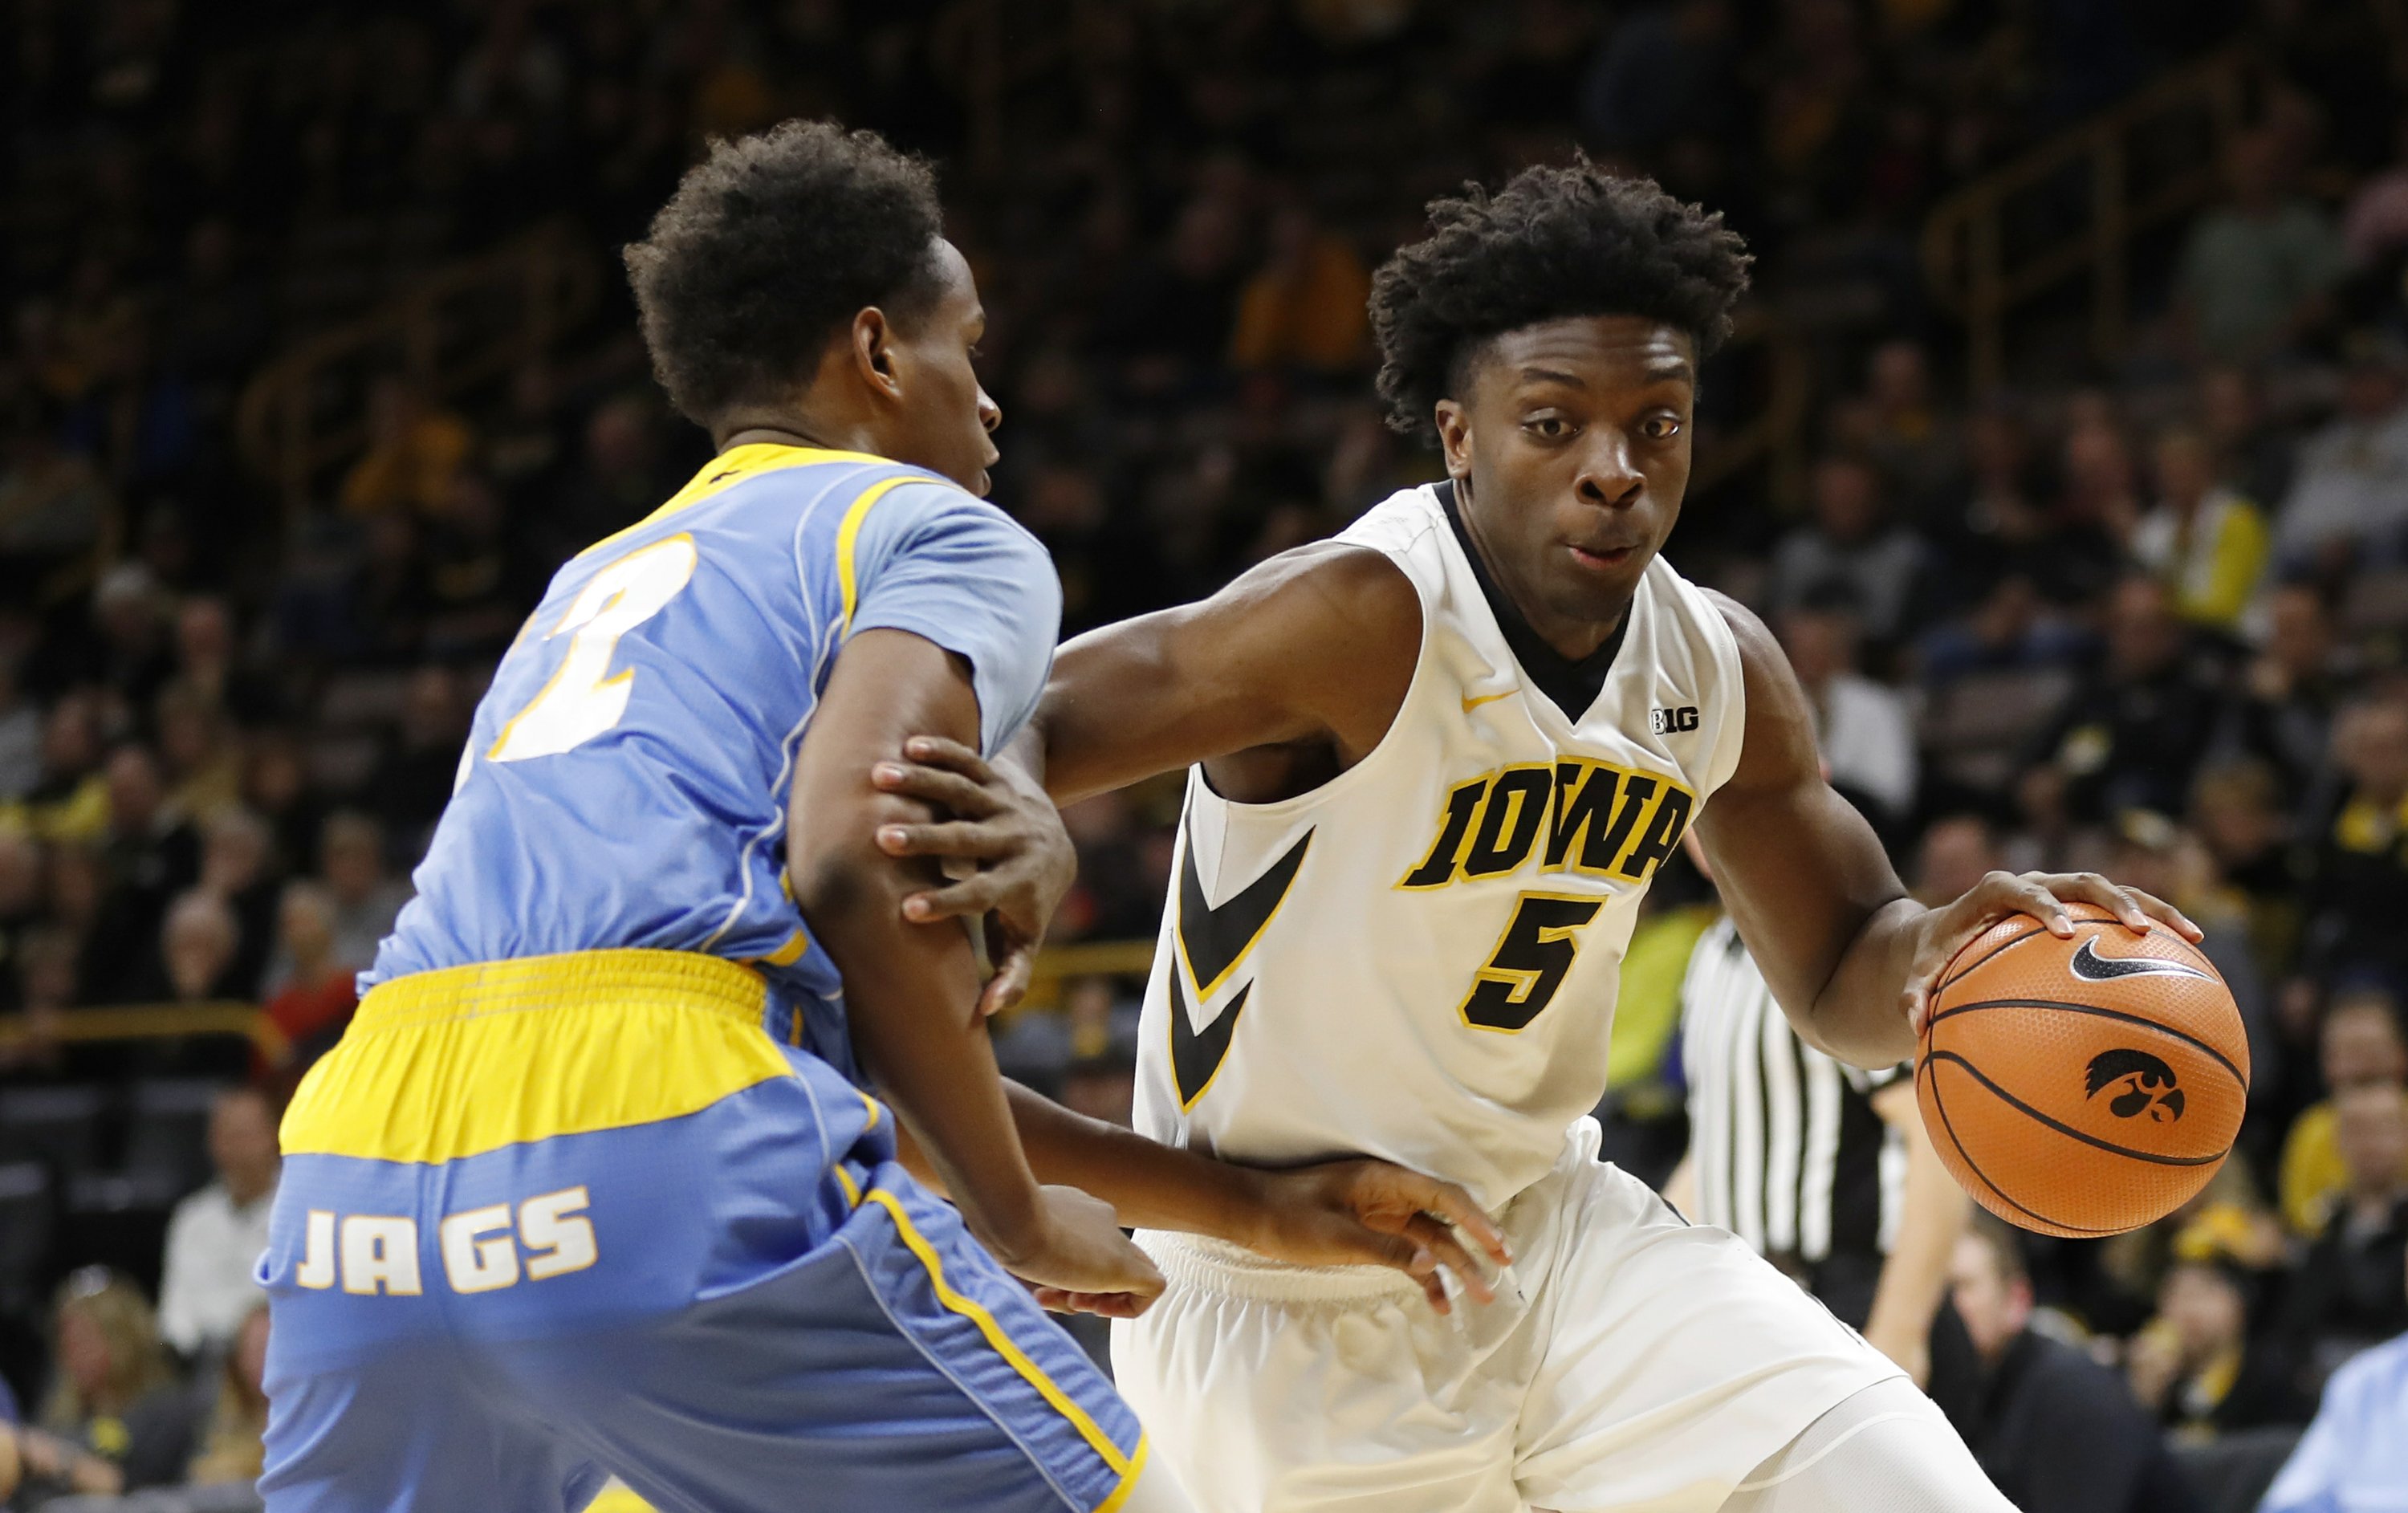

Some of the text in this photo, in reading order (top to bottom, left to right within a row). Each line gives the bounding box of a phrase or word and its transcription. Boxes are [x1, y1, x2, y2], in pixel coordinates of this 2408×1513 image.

[1391, 755, 1696, 891] IOWA
[1457, 889, 1609, 1035] 5
[295, 1184, 599, 1295] JAGS
